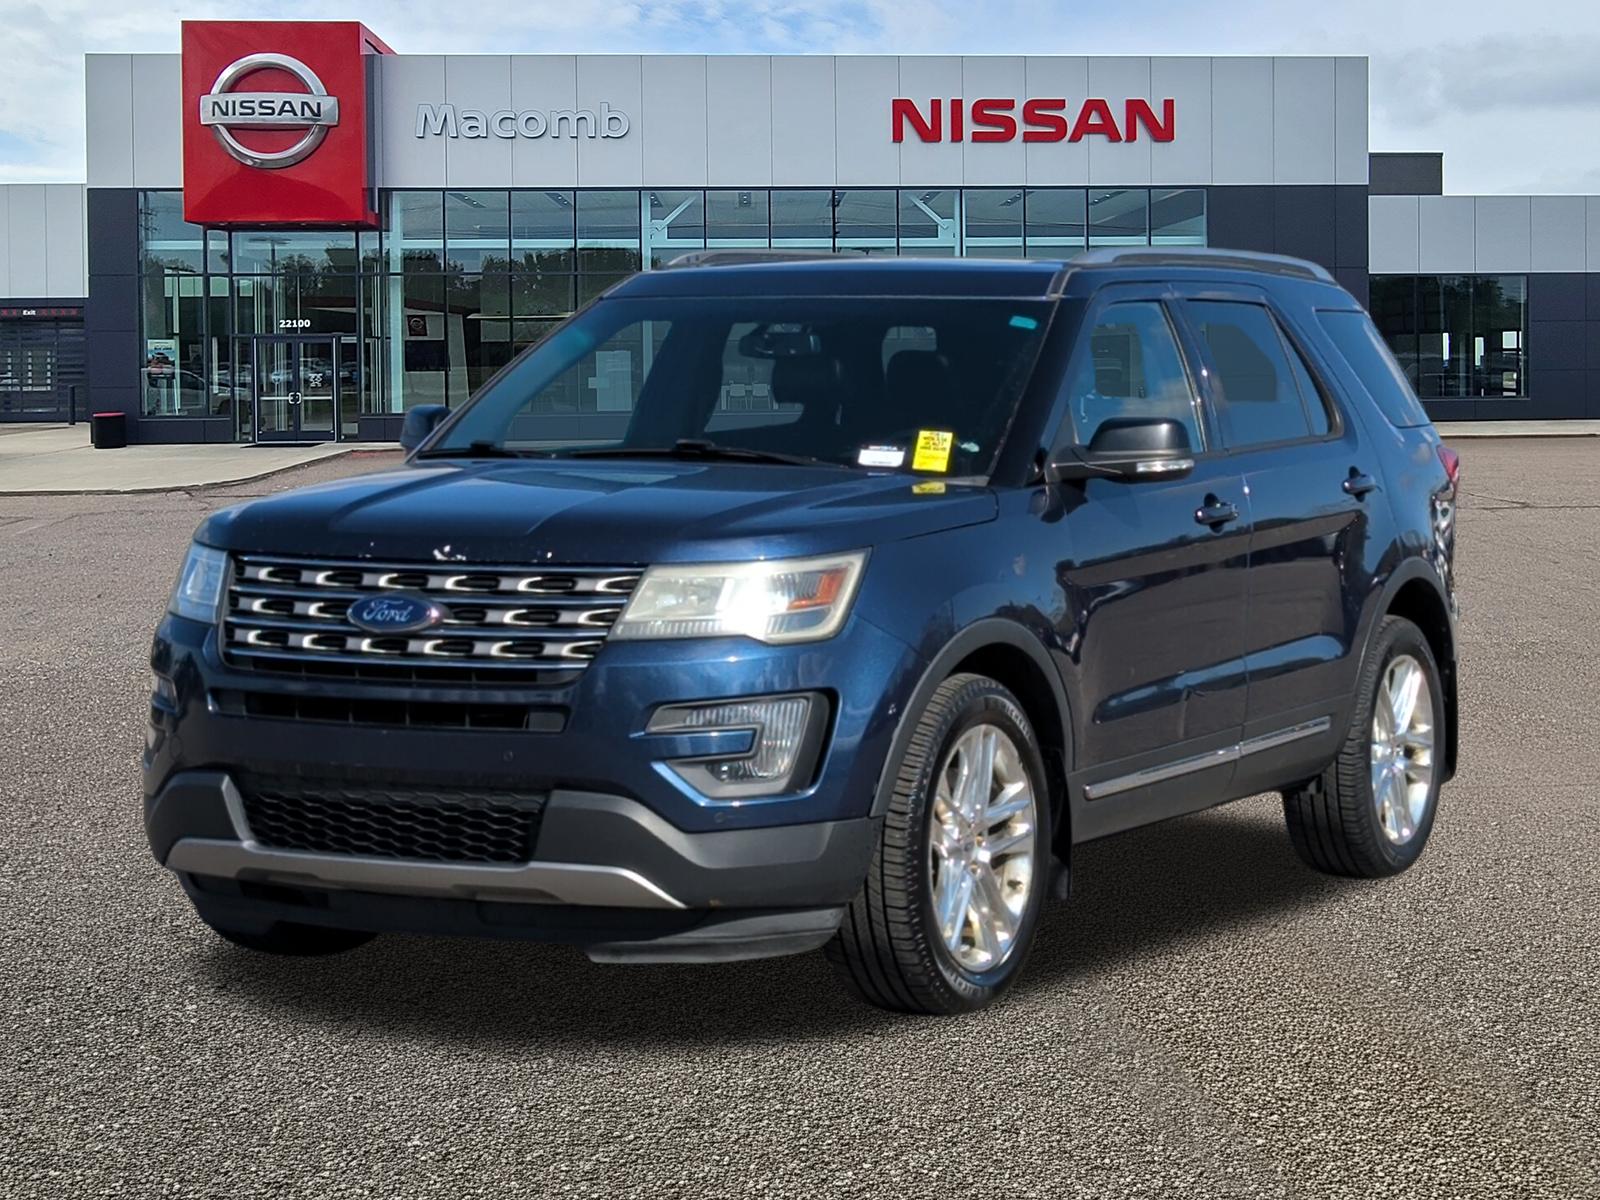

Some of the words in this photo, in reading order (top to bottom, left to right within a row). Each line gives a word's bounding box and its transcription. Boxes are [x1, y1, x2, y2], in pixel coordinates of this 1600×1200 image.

[211, 98, 321, 117] NISSAN
[415, 102, 630, 139] Macomb
[892, 98, 1176, 142] NISSAN
[279, 319, 311, 328] 22100
[361, 599, 414, 622] Ford
